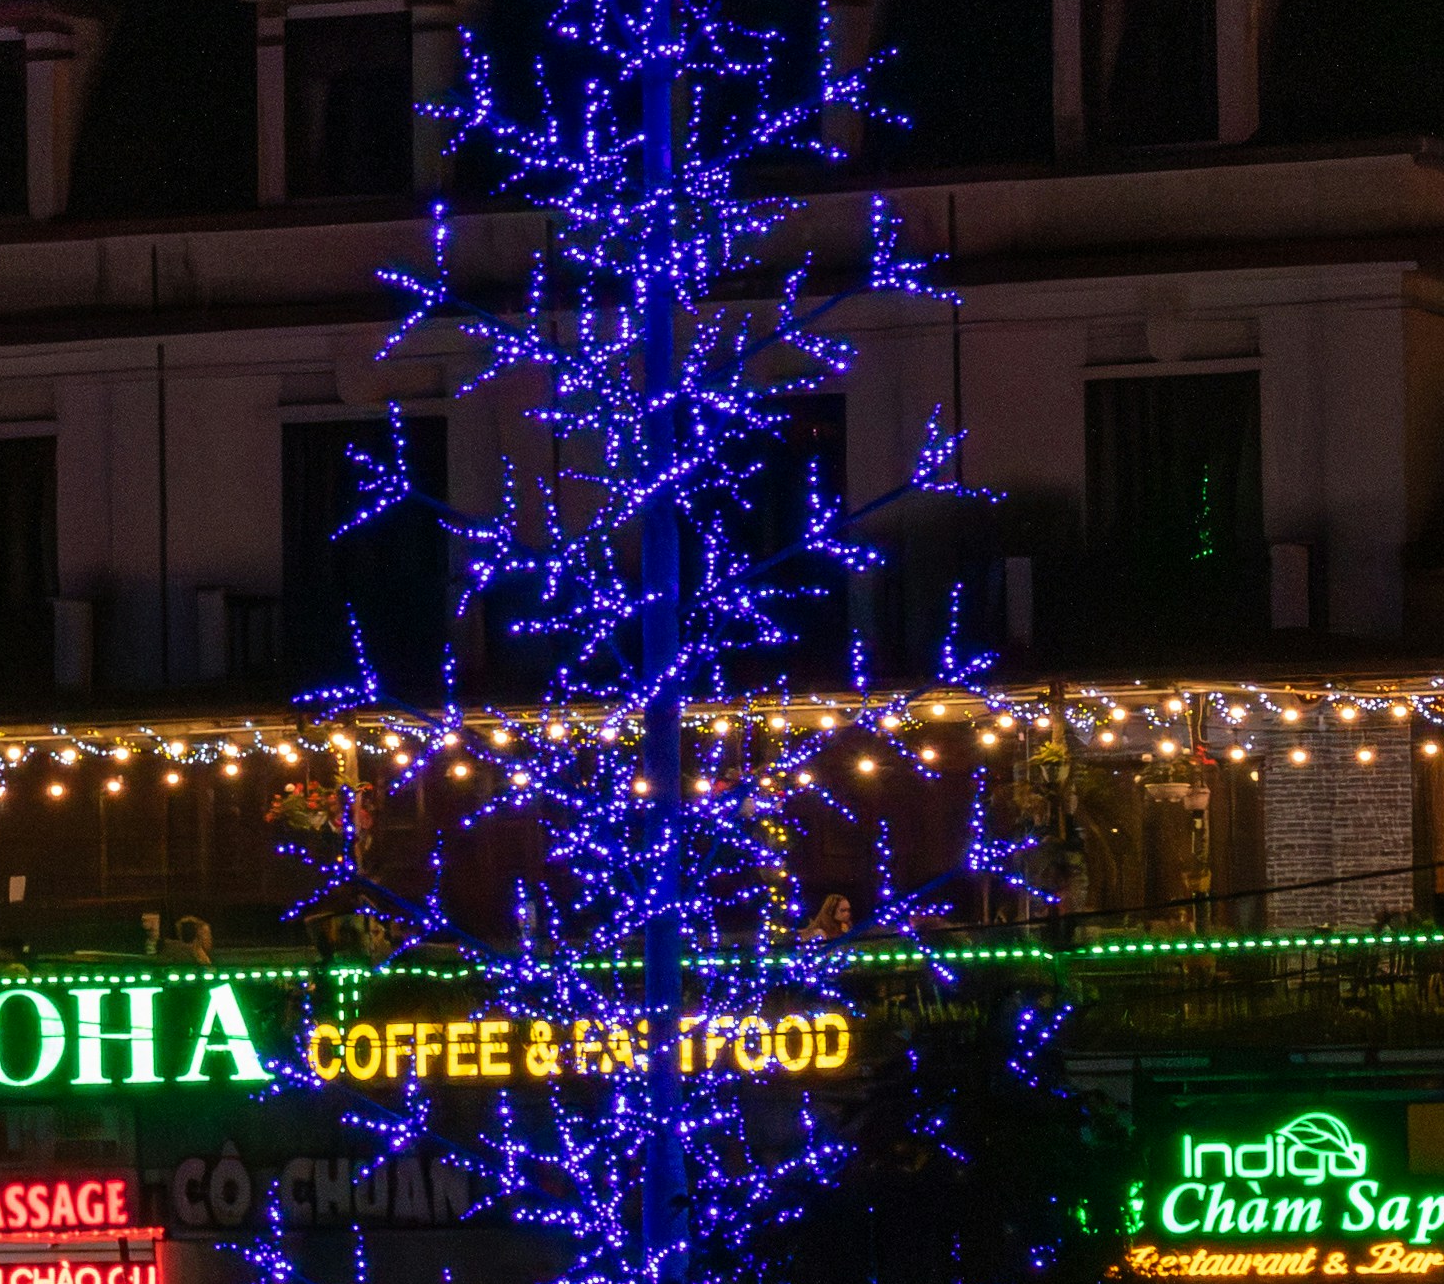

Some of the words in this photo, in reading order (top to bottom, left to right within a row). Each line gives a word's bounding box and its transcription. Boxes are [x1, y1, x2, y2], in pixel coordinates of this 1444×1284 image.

[309, 1021, 510, 1080] COFFEE
[526, 1019, 562, 1077] &
[1182, 1129, 1367, 1185] Indigo
[1162, 1180, 1322, 1233] Chàm
[1126, 1245, 1317, 1277] Restaurant
[1324, 1252, 1348, 1274] &
